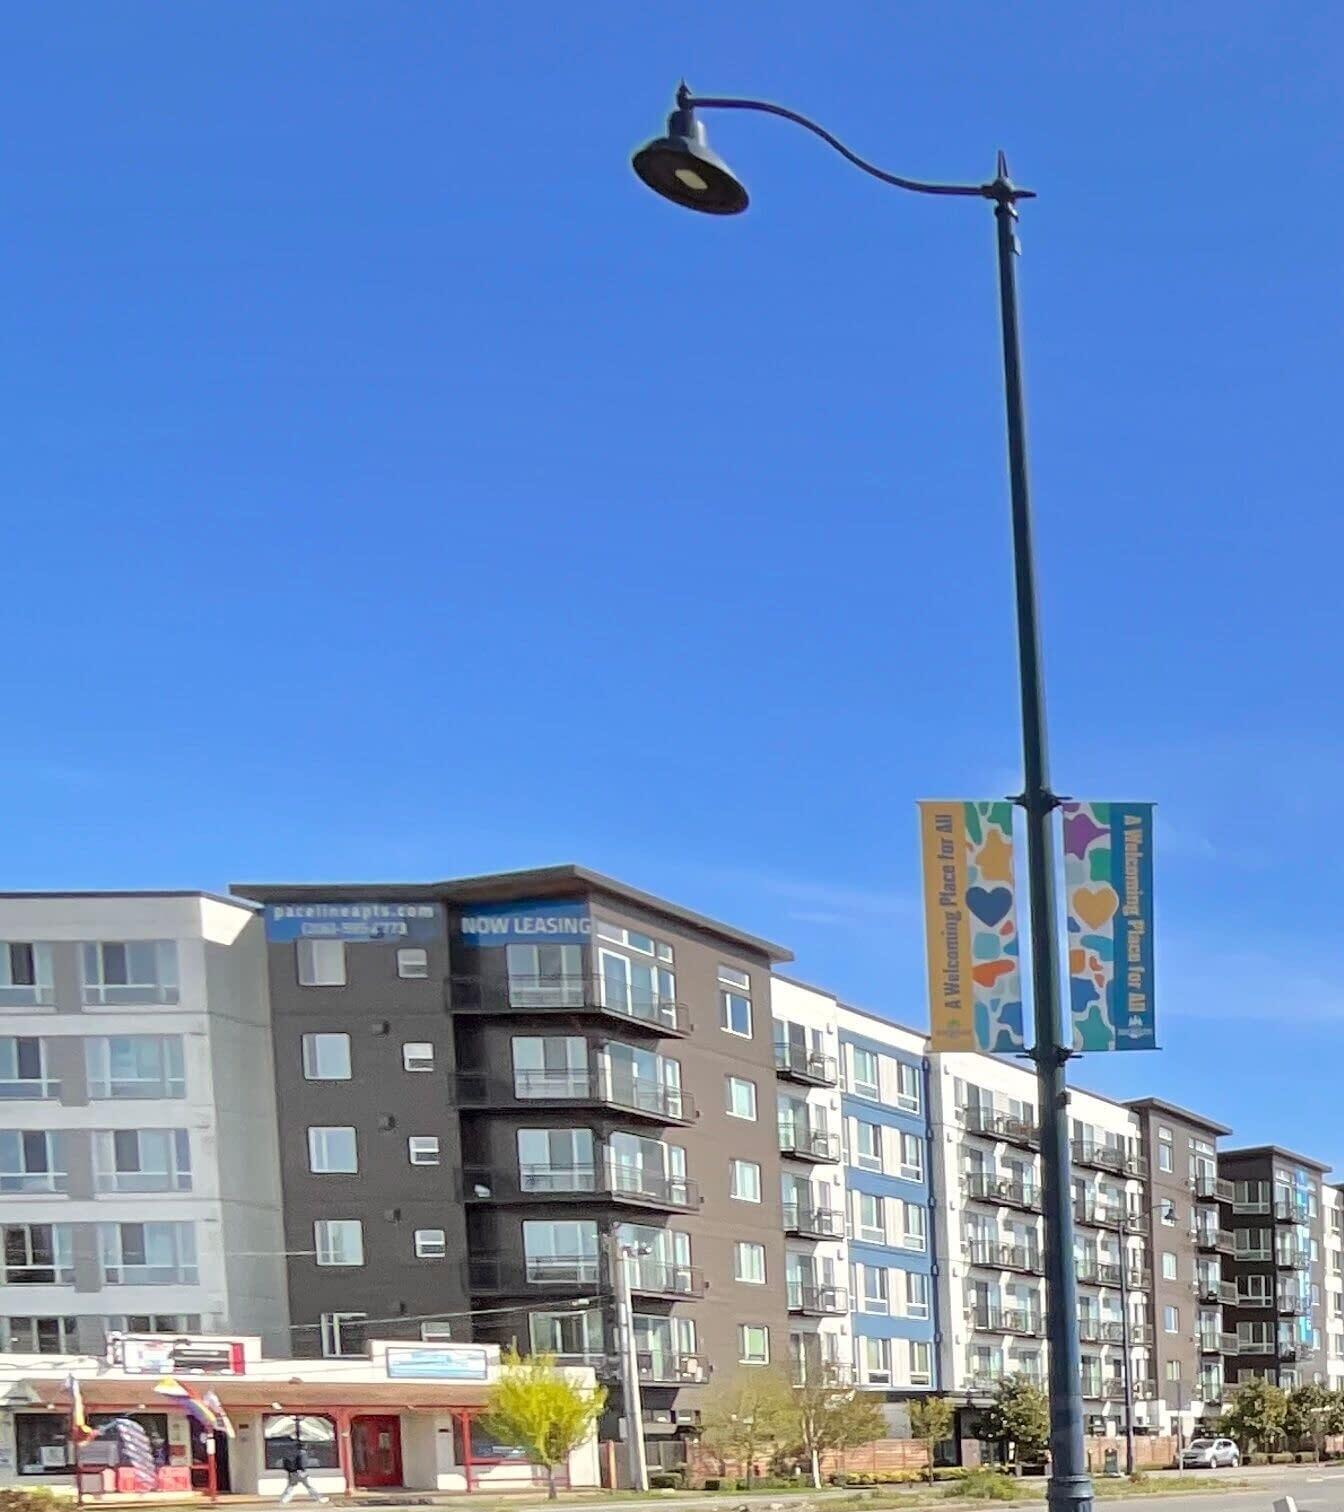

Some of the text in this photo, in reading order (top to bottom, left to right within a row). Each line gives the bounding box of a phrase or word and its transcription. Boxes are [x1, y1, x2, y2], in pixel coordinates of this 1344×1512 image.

[935, 814, 952, 833] All
[1124, 815, 1142, 825] A
[937, 838, 954, 859] for
[1122, 828, 1143, 916] Welcoming
[939, 865, 957, 906] Place
[462, 917, 591, 934] NOW LEASING
[1128, 919, 1145, 962] Place
[942, 910, 961, 996] Welcoming
[1128, 966, 1146, 990] for
[944, 1000, 961, 1009] A
[1128, 992, 1146, 1012] All
